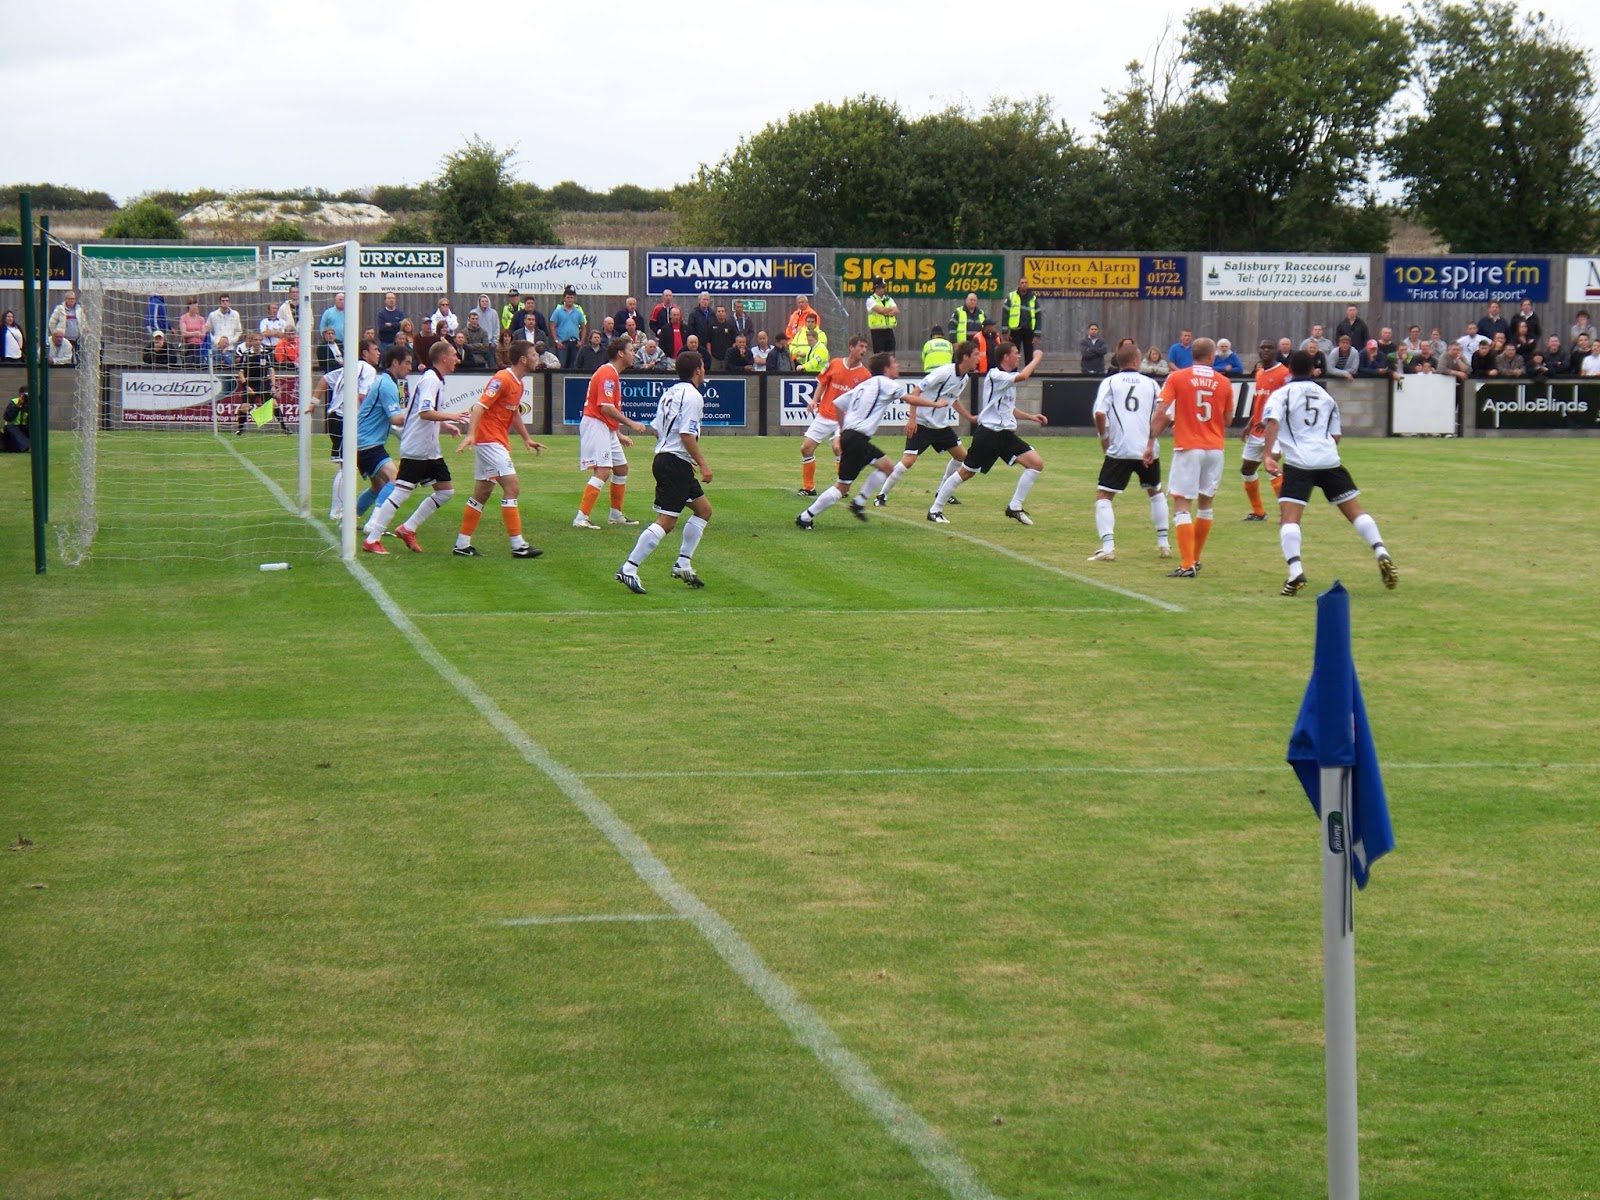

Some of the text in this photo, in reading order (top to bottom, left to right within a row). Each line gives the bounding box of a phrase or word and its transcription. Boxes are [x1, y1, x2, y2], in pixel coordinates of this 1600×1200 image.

[360, 251, 442, 266] URFCARE
[1153, 259, 1177, 270] Tel:
[456, 253, 598, 279] Sarum Physiotherapy
[844, 257, 937, 280] SIGNS
[951, 262, 993, 276] 01722
[1028, 259, 1137, 272] Wilton Alarm
[1224, 261, 1352, 273] Salisbury Racecourse
[380, 270, 444, 279] Maintenance
[591, 268, 628, 279] Centre
[1032, 273, 1131, 286] Services Ltd
[1147, 272, 1181, 284] 01722
[1238, 273, 1338, 285] Tel: (01722) 326461
[381, 285, 444, 293] www.ecosolve.co.uk
[480, 281, 603, 292] www.sarumphysico.uk
[694, 280, 772, 290] 01722 411078
[843, 281, 937, 293] In Mion Ltd
[945, 278, 999, 292] 416945
[1145, 285, 1184, 297] 744744
[1031, 288, 1140, 298] ww.wiltonalarms.net
[1209, 287, 1363, 300] www.salisburyracecourse.co.uk
[1442, 288, 1460, 300] for
[1462, 288, 1489, 300] local
[125, 381, 212, 395] Woodbury
[1191, 378, 1219, 390] WHITE
[1125, 385, 1139, 412] 6
[1196, 390, 1213, 422] 5
[1304, 395, 1319, 426] 5
[1483, 385, 1588, 428] ApolloBlinds
